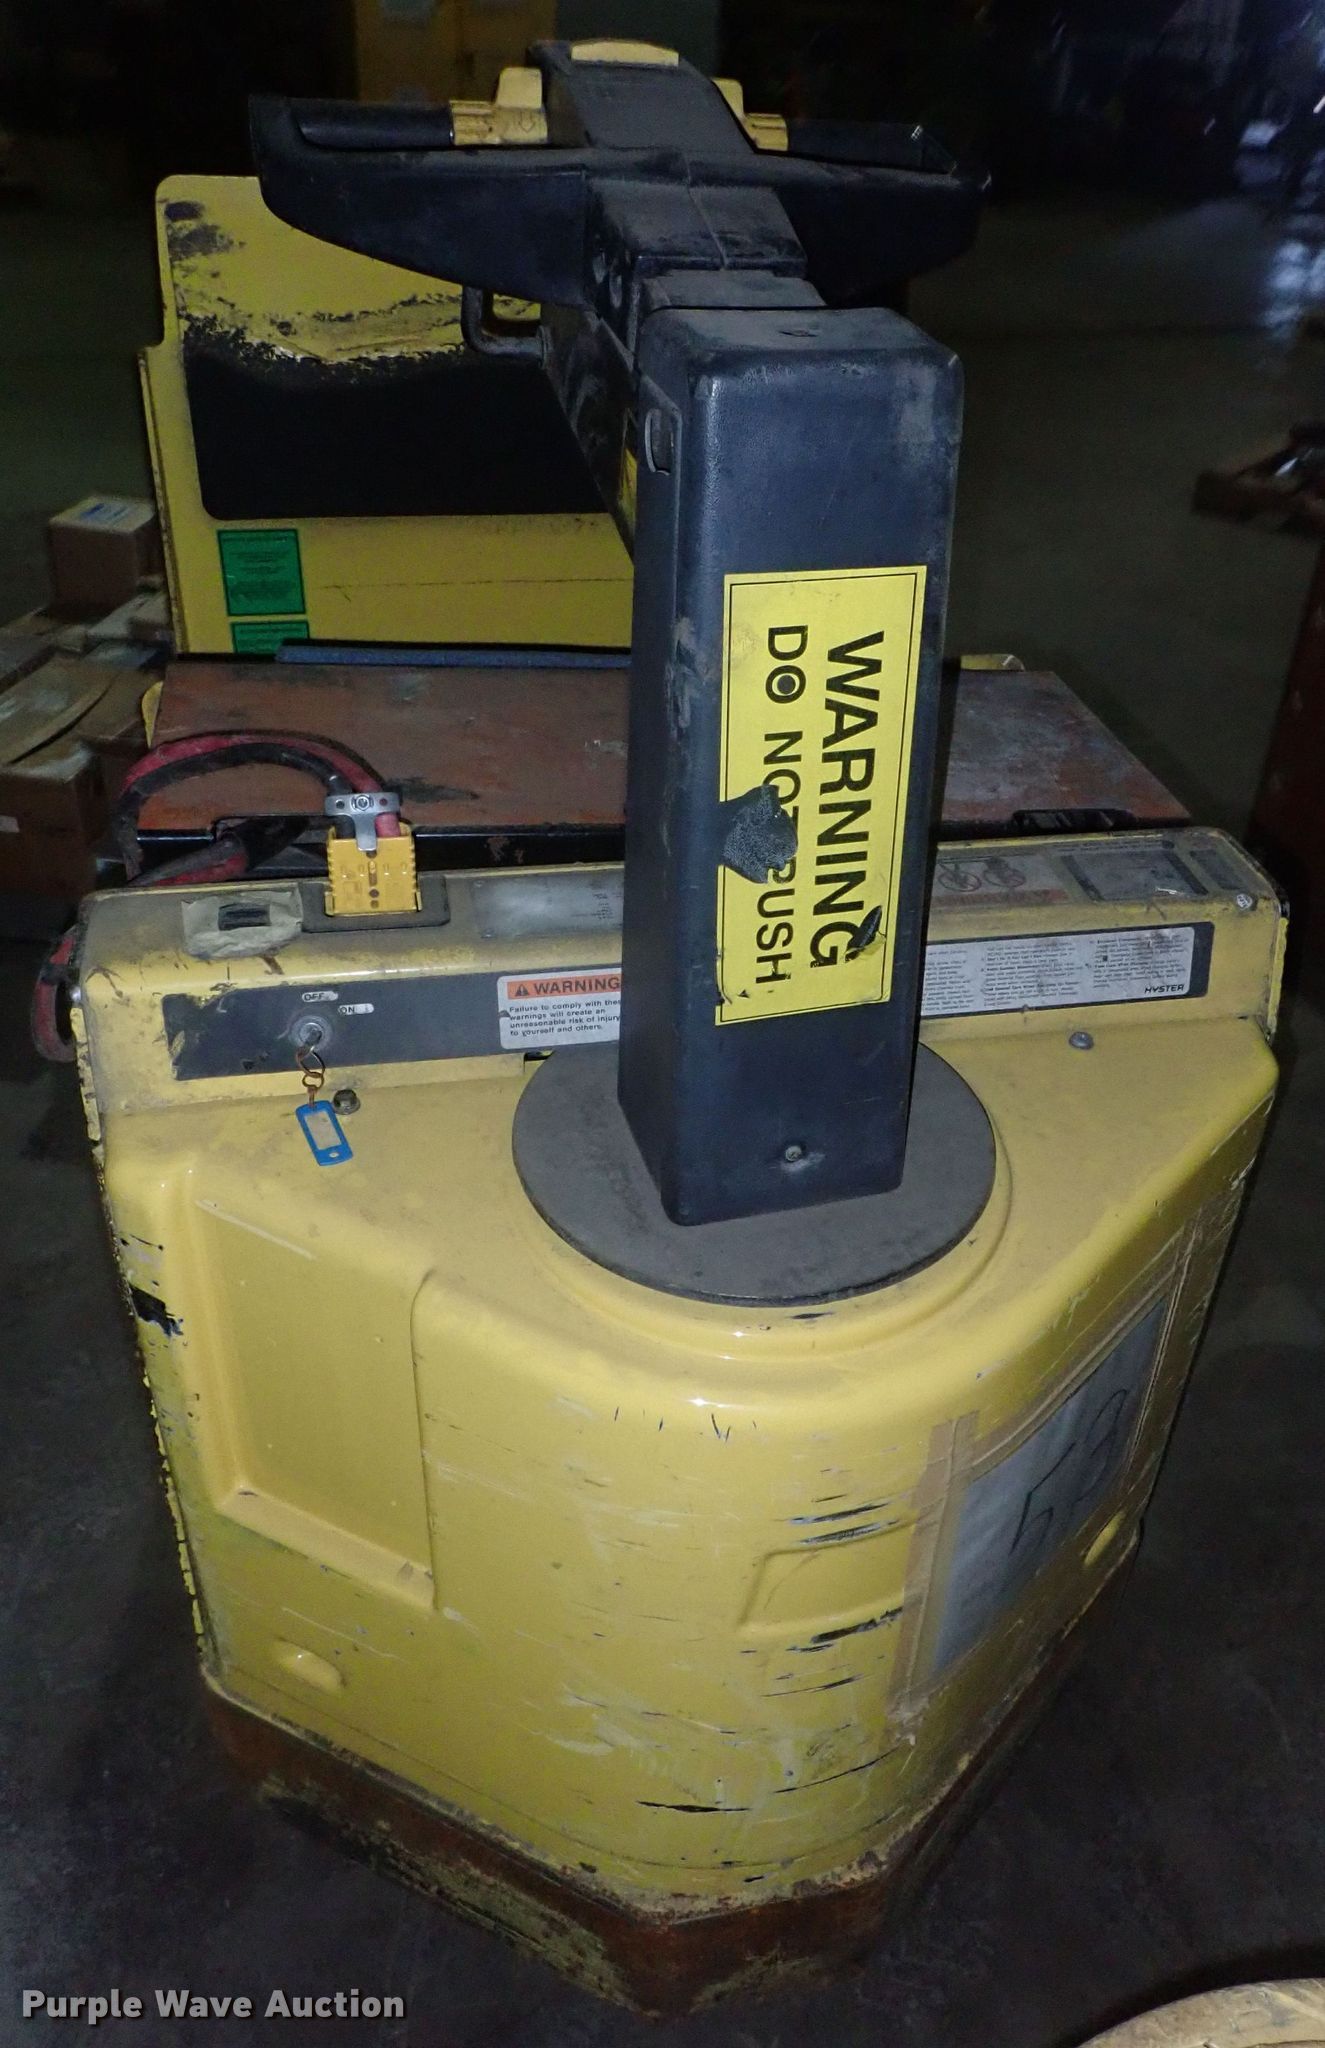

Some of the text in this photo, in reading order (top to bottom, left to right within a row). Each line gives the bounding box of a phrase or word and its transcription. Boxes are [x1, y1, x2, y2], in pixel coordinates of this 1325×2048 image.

[765, 625, 808, 704] DO
[762, 731, 803, 845] NO
[809, 630, 885, 968] WARNING
[533, 977, 620, 995] WARNING
[1144, 983, 1185, 994] HYSTER
[304, 992, 324, 1001] OFF
[552, 1001, 581, 1009] comply
[585, 999, 602, 1007] with
[340, 1006, 355, 1014] ON
[510, 1012, 547, 1021] warnings
[550, 1010, 563, 1018] will
[510, 1019, 566, 1029] unreasonable
[522, 1026, 554, 1037] yourself
[557, 1025, 572, 1033] and
